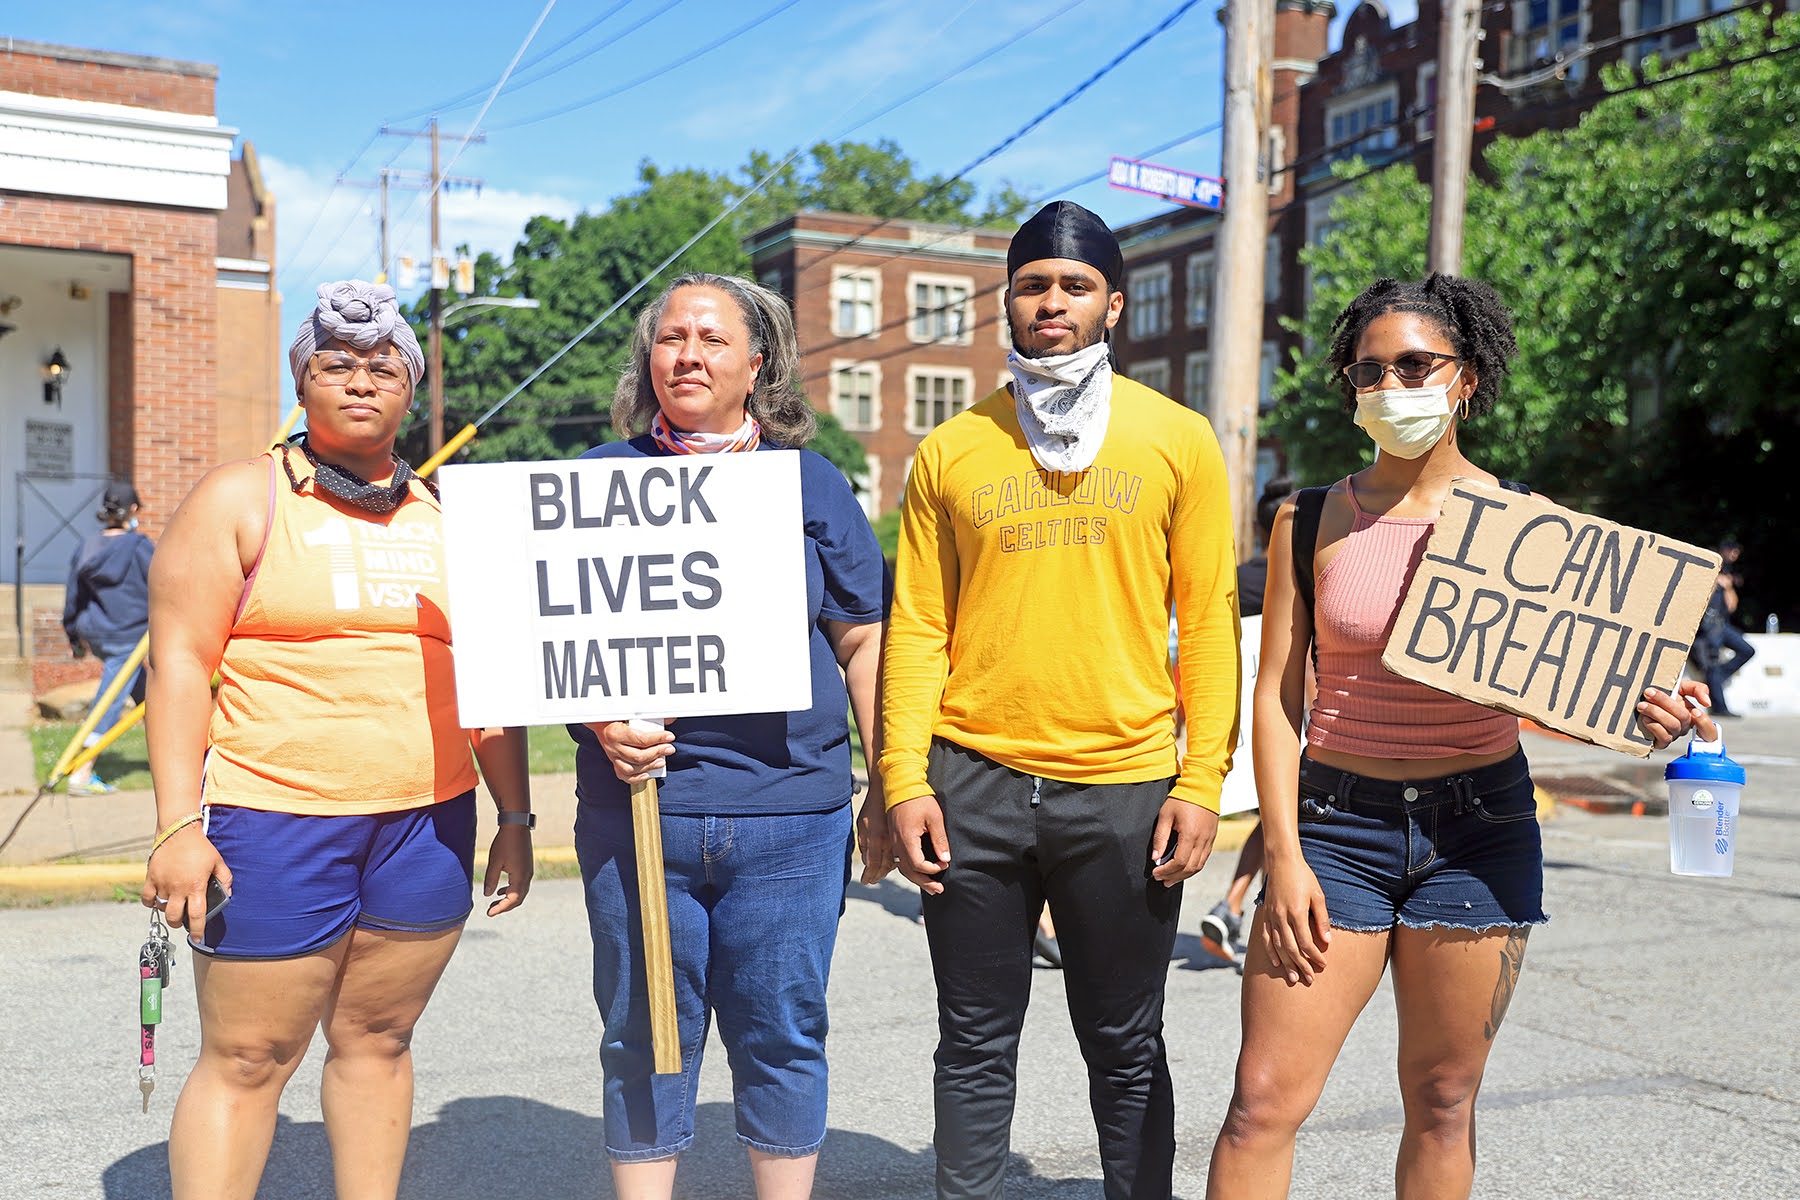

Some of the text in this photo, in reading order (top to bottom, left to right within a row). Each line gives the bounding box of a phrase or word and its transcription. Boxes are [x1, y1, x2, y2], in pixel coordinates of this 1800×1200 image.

[530, 466, 717, 530] BLACK
[972, 466, 1142, 529] CARLOW
[351, 520, 442, 545] TRACK
[1000, 517, 1107, 553] CELTICS
[1426, 488, 1715, 626] I CAN'T
[362, 548, 437, 573] MIND
[536, 551, 722, 616] LIVES
[365, 582, 424, 609] VSX
[542, 635, 727, 699] MATTER
[1405, 576, 1689, 745] BREATHE
[1715, 801, 1725, 836] Blender
[1723, 810, 1731, 837] Bottle
